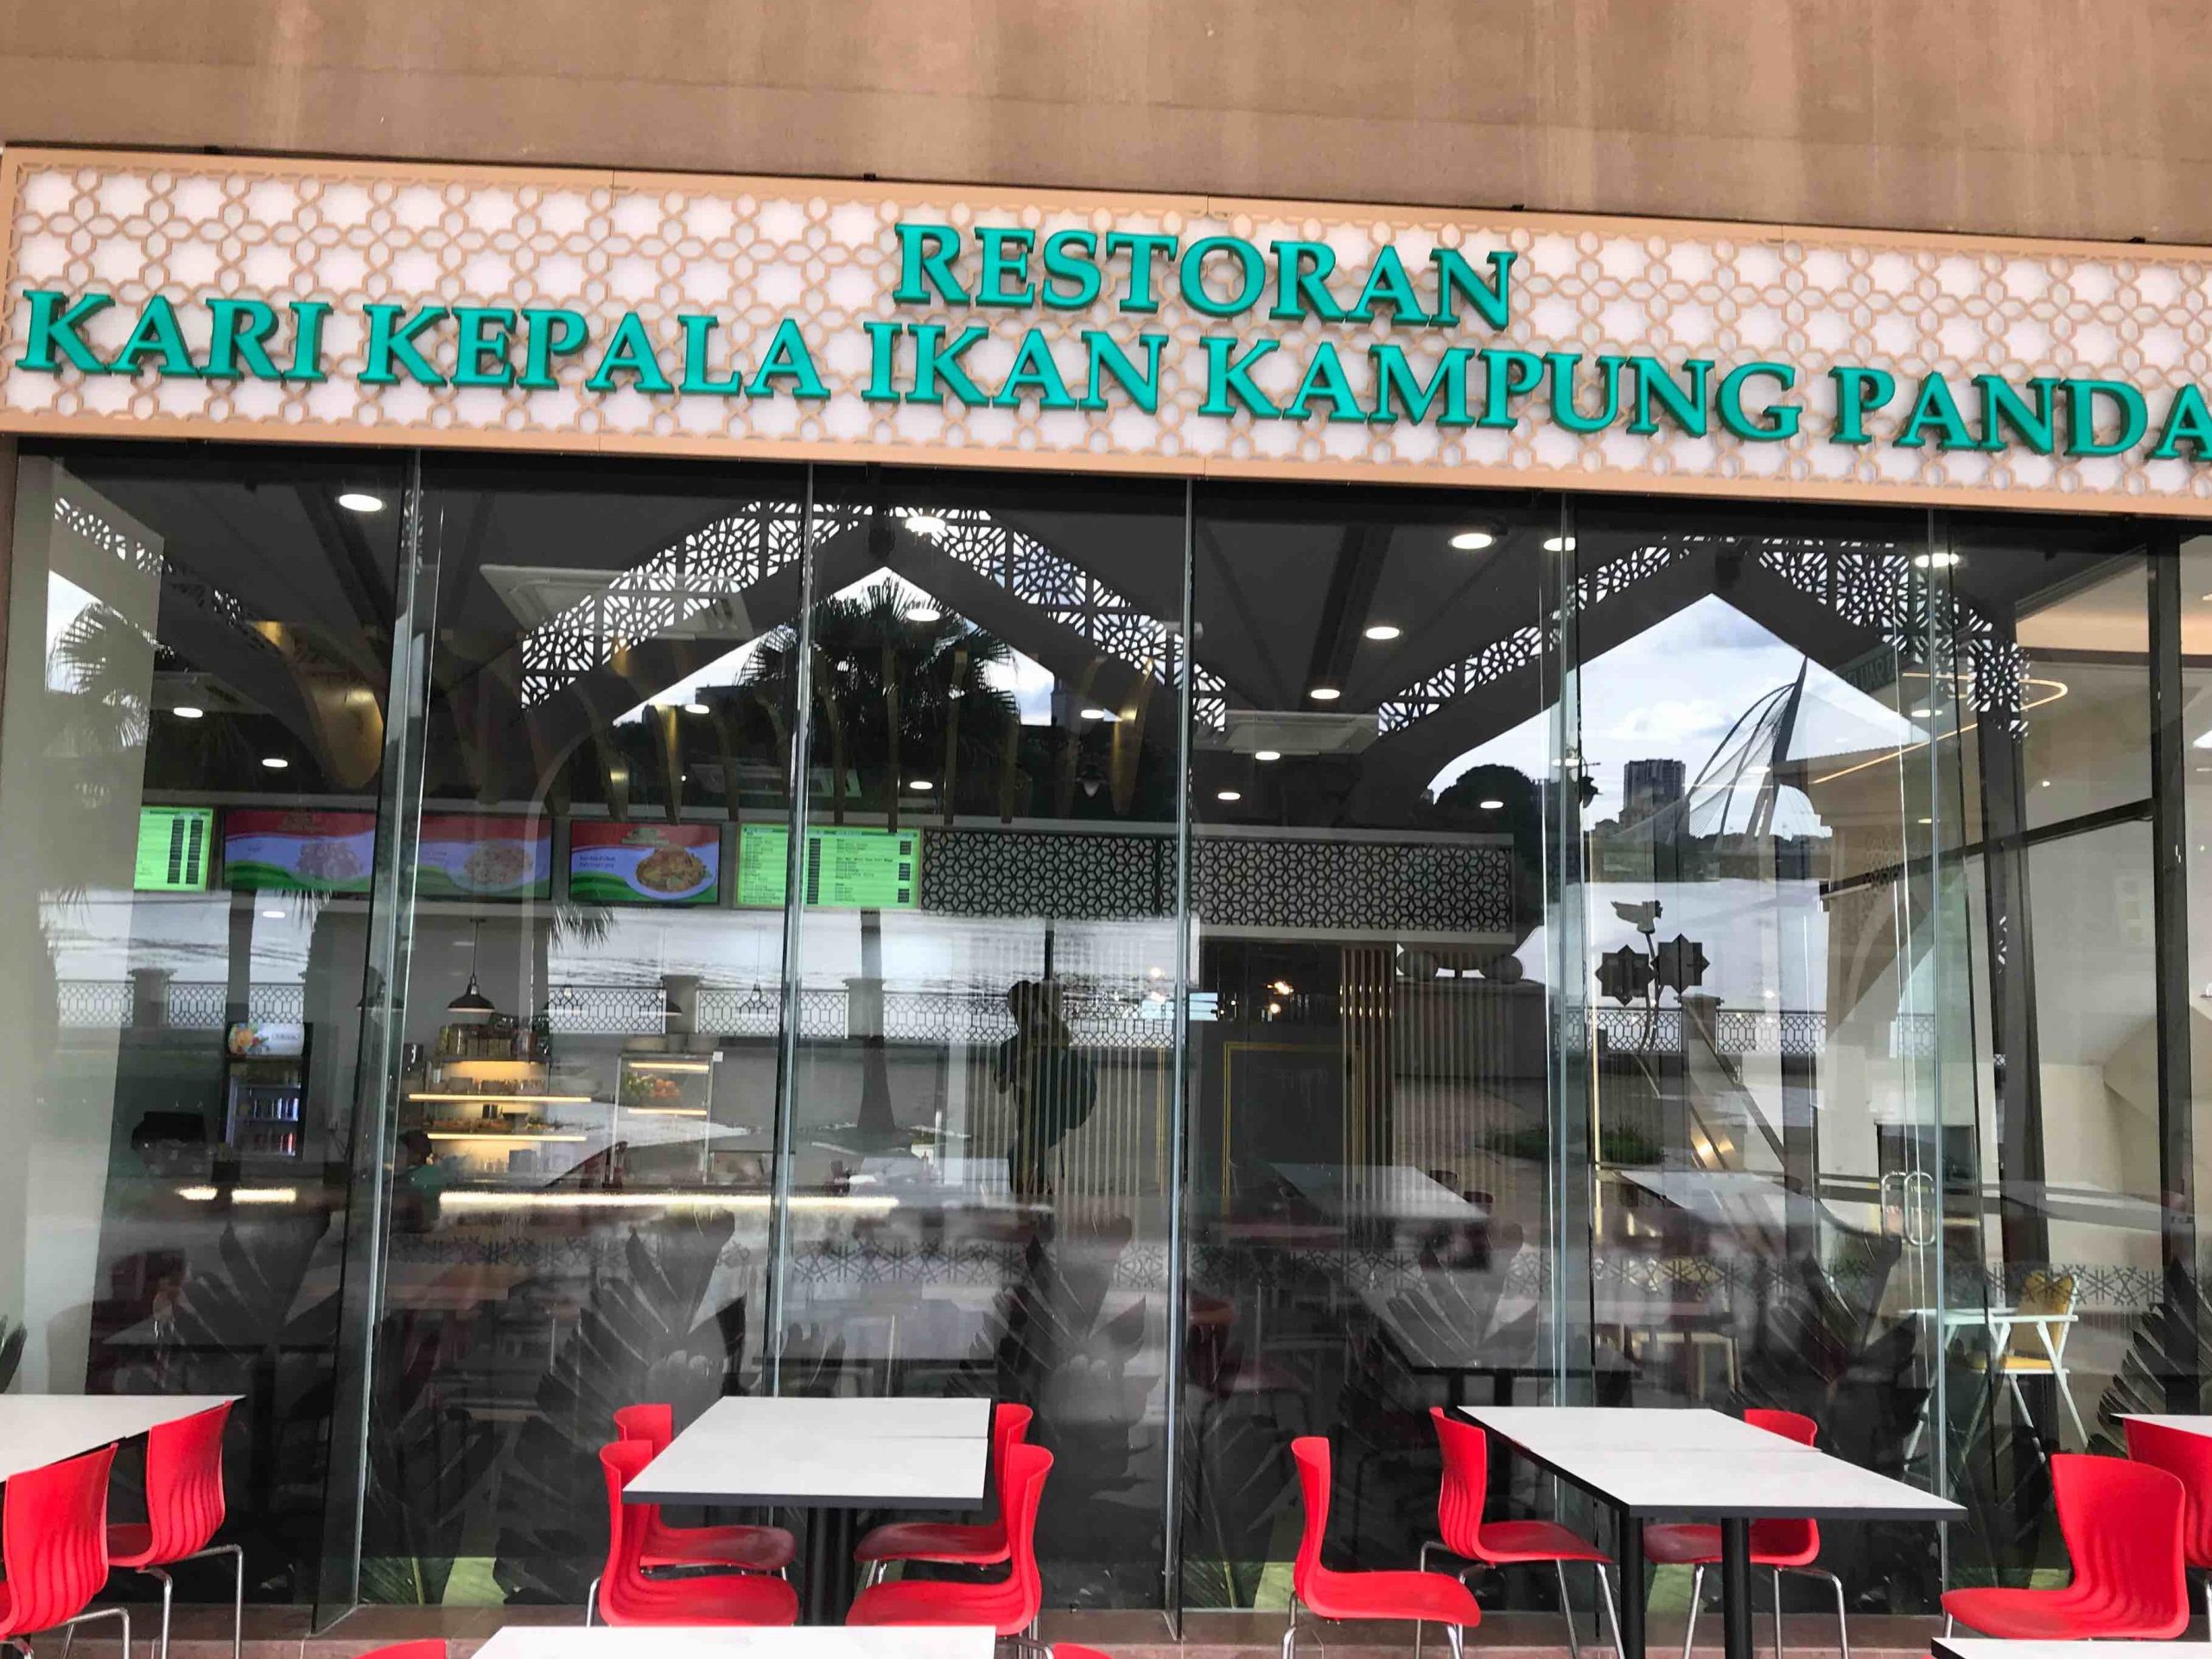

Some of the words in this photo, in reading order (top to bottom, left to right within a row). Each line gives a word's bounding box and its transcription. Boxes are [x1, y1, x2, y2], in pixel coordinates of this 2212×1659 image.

[892, 223, 1518, 331] RESTORAN
[14, 289, 331, 385] KARI
[356, 302, 832, 400] KEPALA
[861, 321, 1169, 415] IKAN
[1198, 335, 1802, 442] KAMPUNG
[1829, 365, 2212, 463] PANDA
